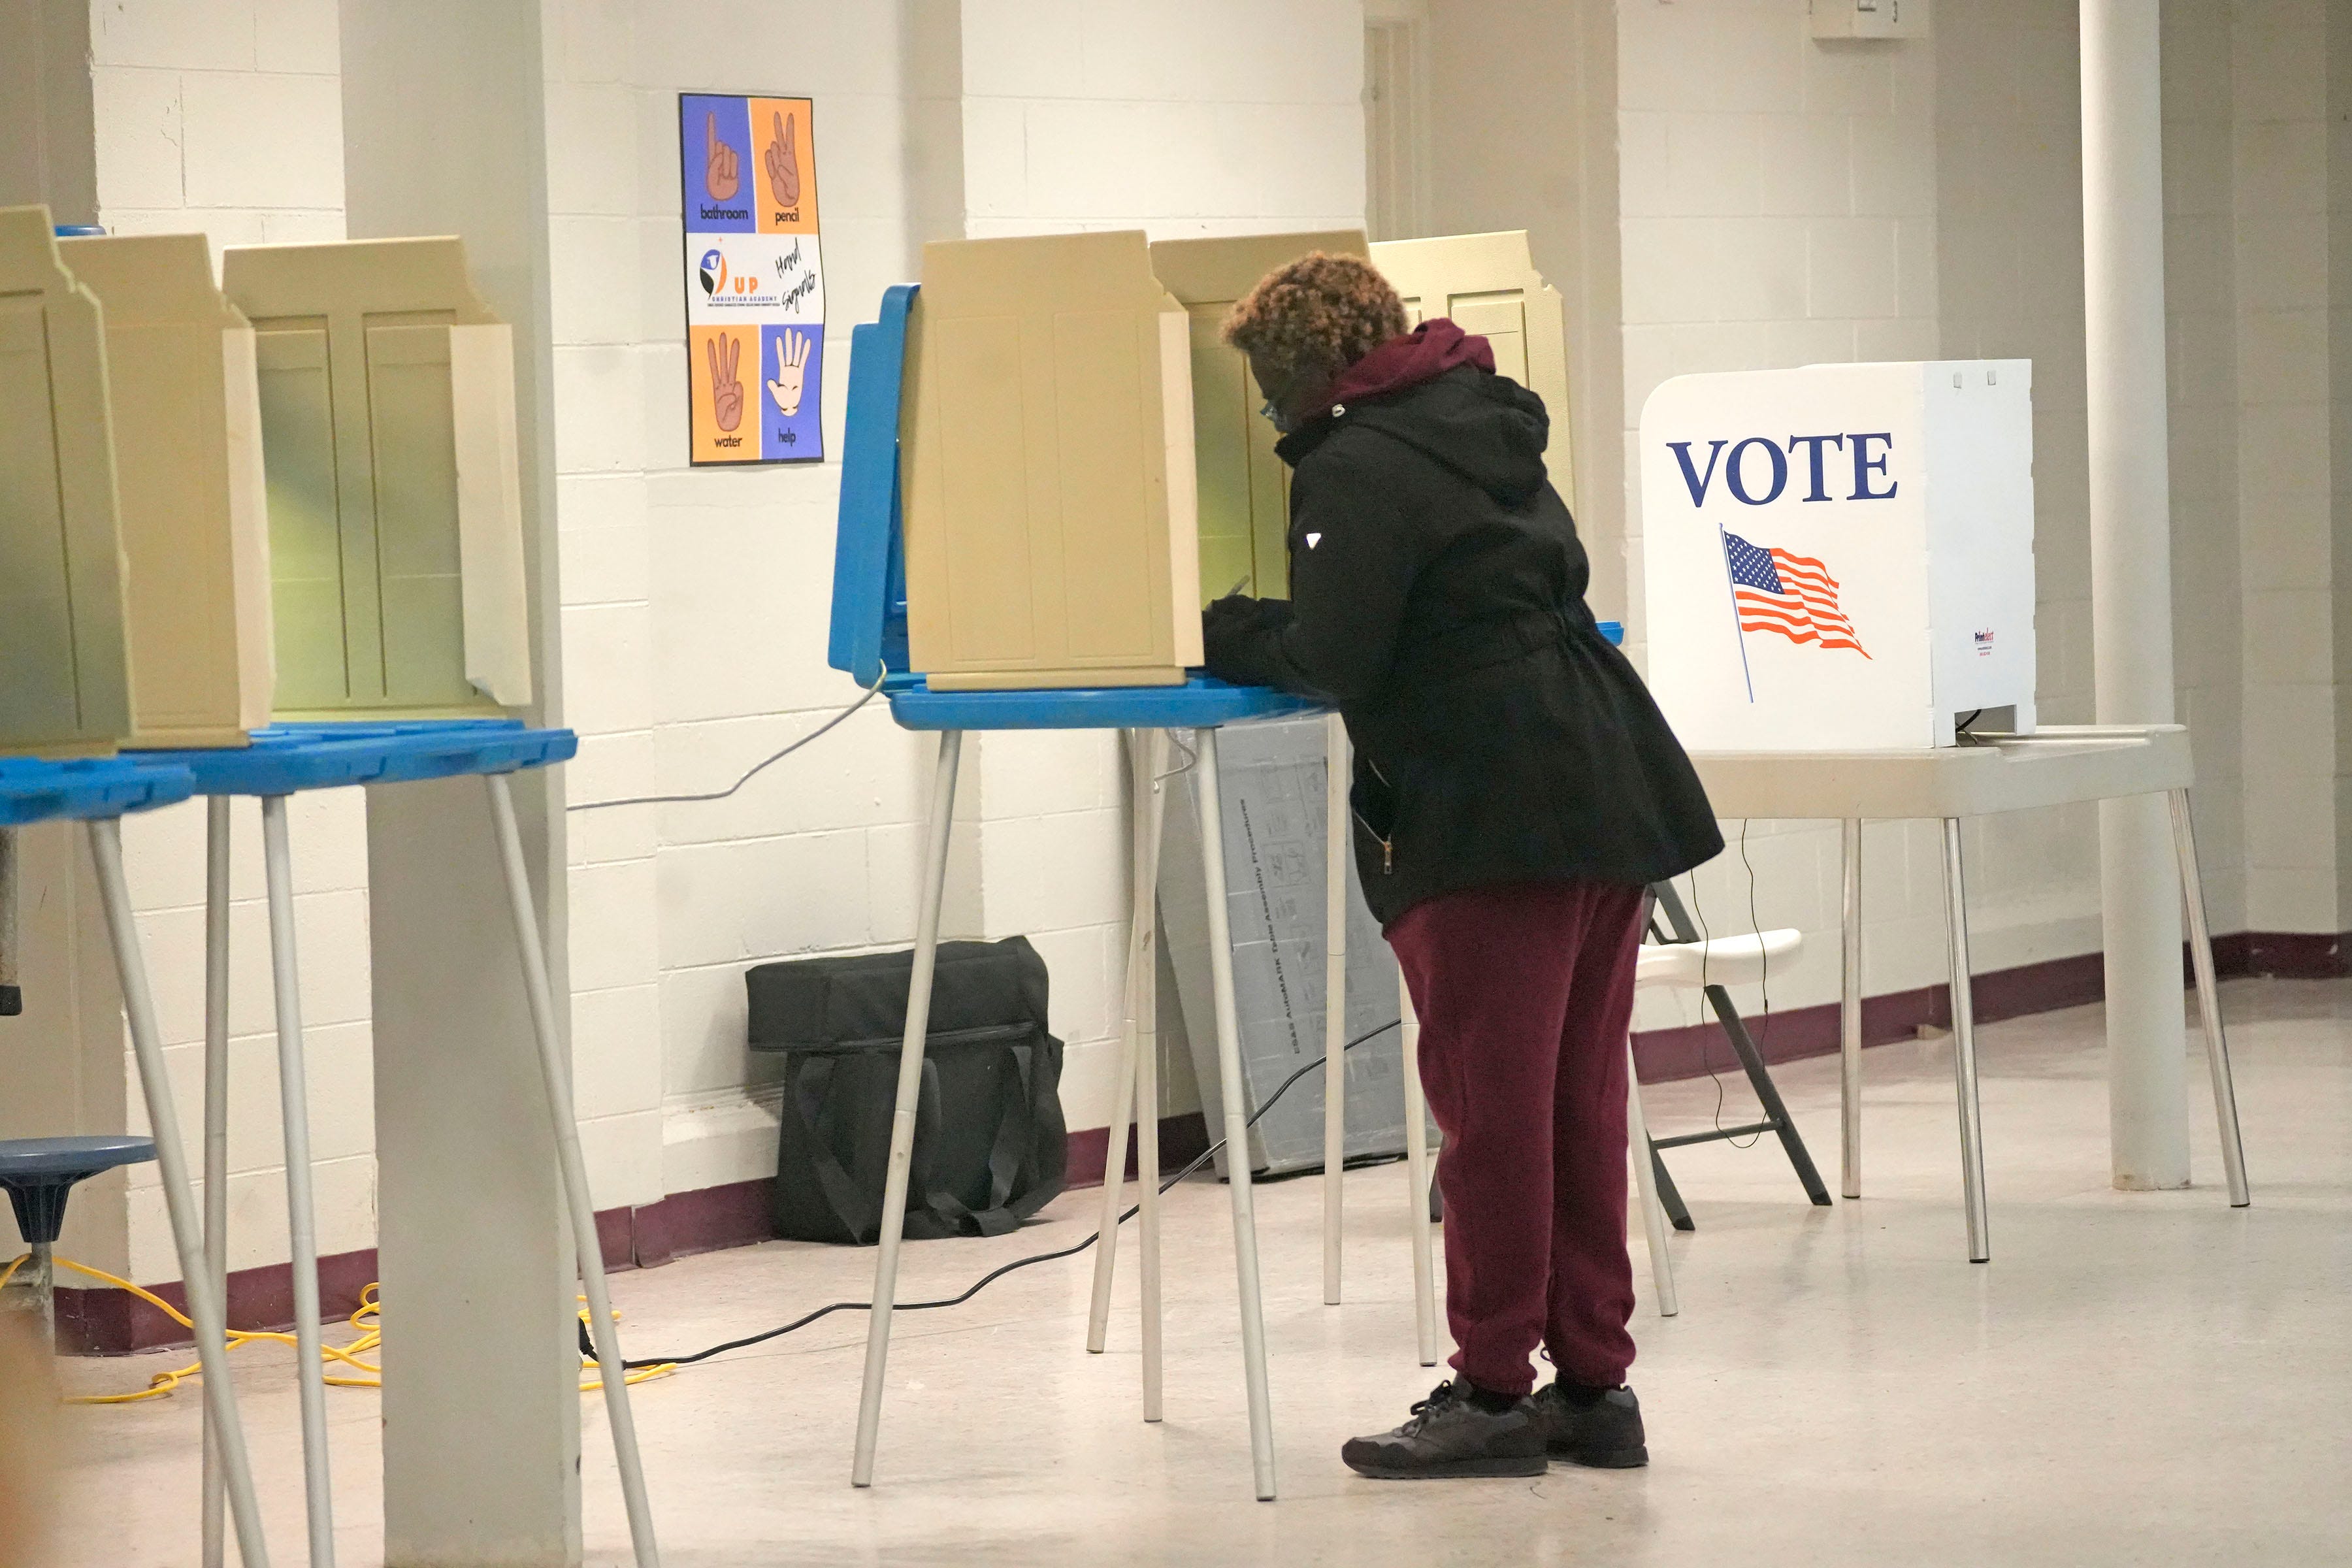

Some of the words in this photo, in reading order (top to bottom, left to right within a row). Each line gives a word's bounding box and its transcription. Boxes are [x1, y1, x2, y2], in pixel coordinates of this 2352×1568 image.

[700, 204, 749, 220] bathroom
[775, 207, 800, 226] pencil
[714, 434, 743, 448] water
[778, 427, 796, 447] help
[1666, 432, 1898, 508] VOTE
[1241, 799, 1258, 863] Procedures
[1256, 867, 1271, 921] Assembly
[1268, 924, 1278, 953] Table
[1275, 958, 1292, 1019] AutoMARK
